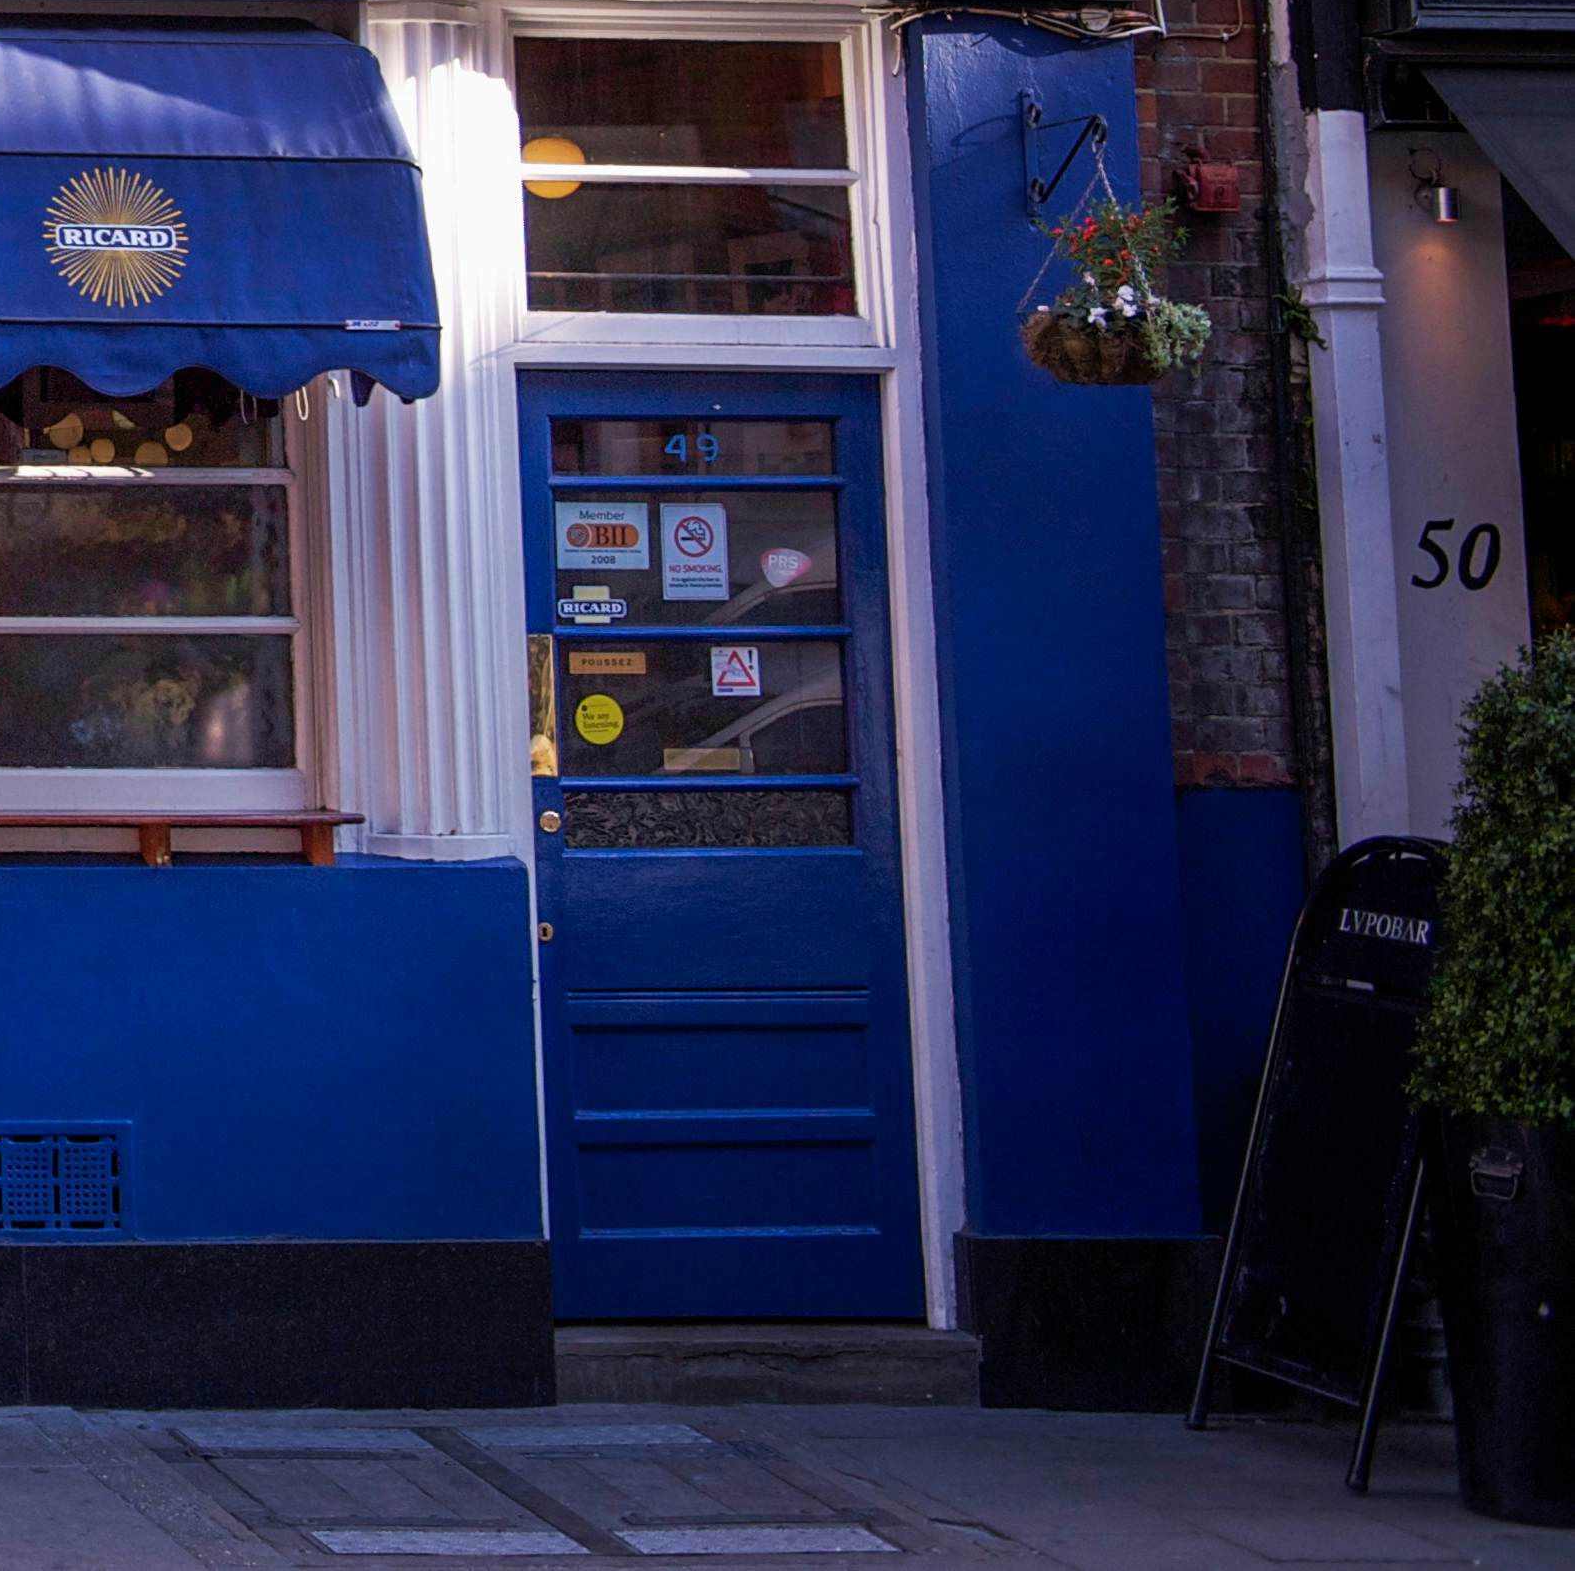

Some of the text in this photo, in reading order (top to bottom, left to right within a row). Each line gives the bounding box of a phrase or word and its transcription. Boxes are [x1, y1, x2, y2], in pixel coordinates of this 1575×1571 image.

[64, 227, 170, 249] RICARD
[664, 431, 720, 462] 49
[579, 509, 625, 521] Member
[596, 525, 627, 546] BII
[591, 555, 616, 565] 2008
[768, 554, 799, 569] PRS
[1410, 518, 1501, 592] 50
[669, 564, 681, 573] NO
[563, 603, 623, 613] RICARD
[581, 658, 632, 667] POUSSEZ
